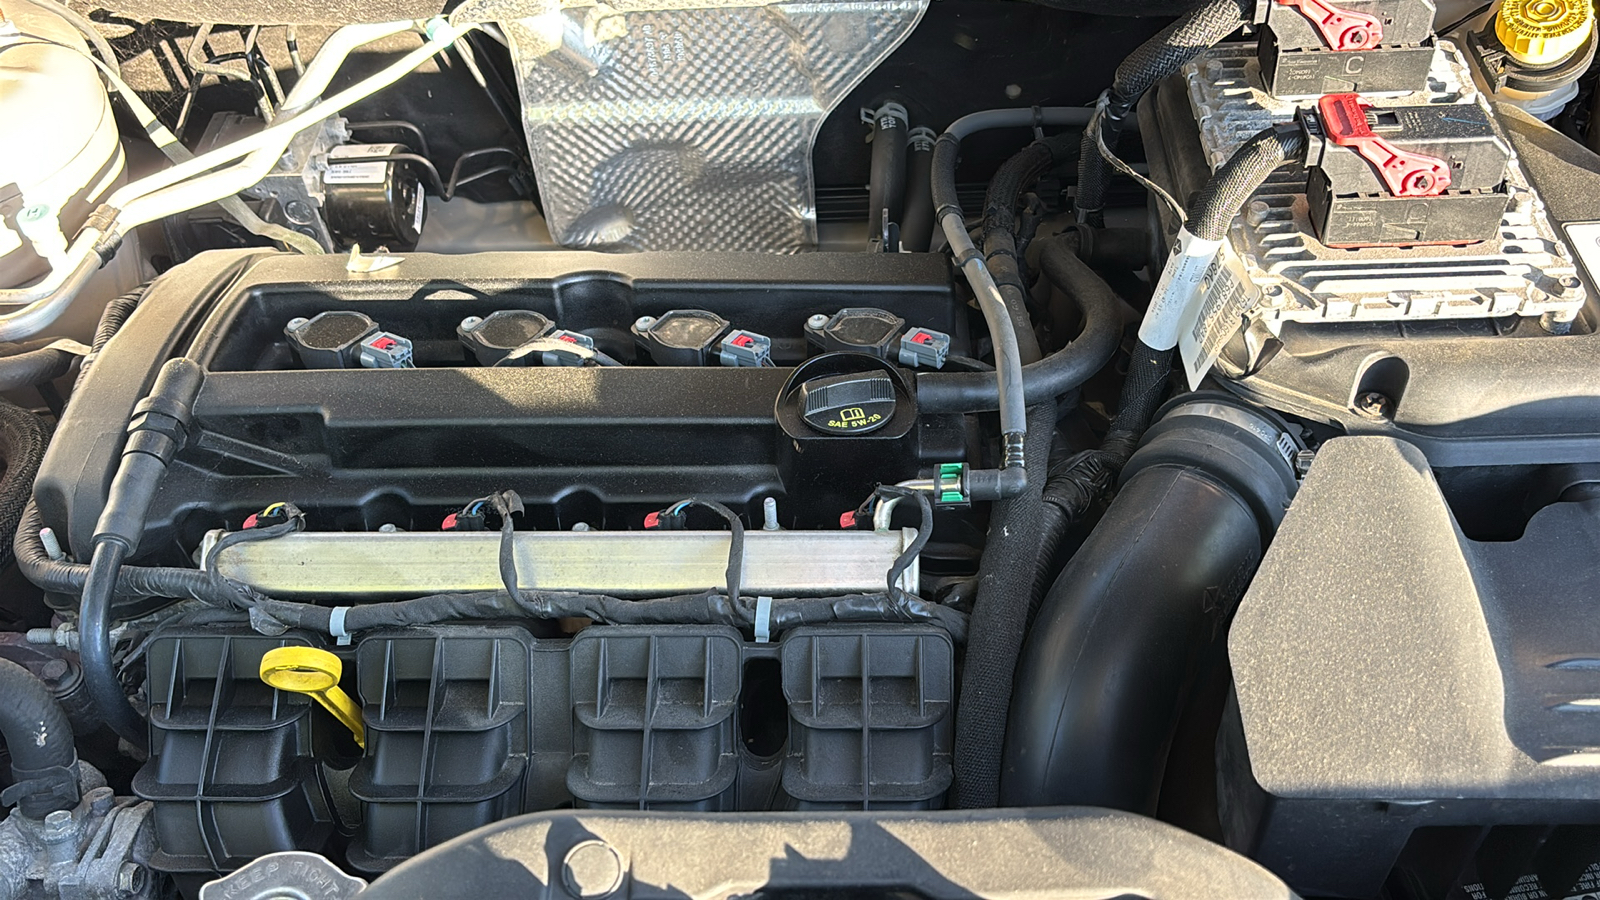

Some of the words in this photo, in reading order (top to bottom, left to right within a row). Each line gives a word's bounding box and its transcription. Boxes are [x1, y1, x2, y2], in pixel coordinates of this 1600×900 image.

[1345, 55, 1365, 74] C
[828, 420, 848, 428] SAE
[851, 413, 881, 428] 5W-20
[222, 861, 279, 900] KEEP
[293, 861, 340, 896] TIGHT
[1471, 890, 1487, 900] FOR
